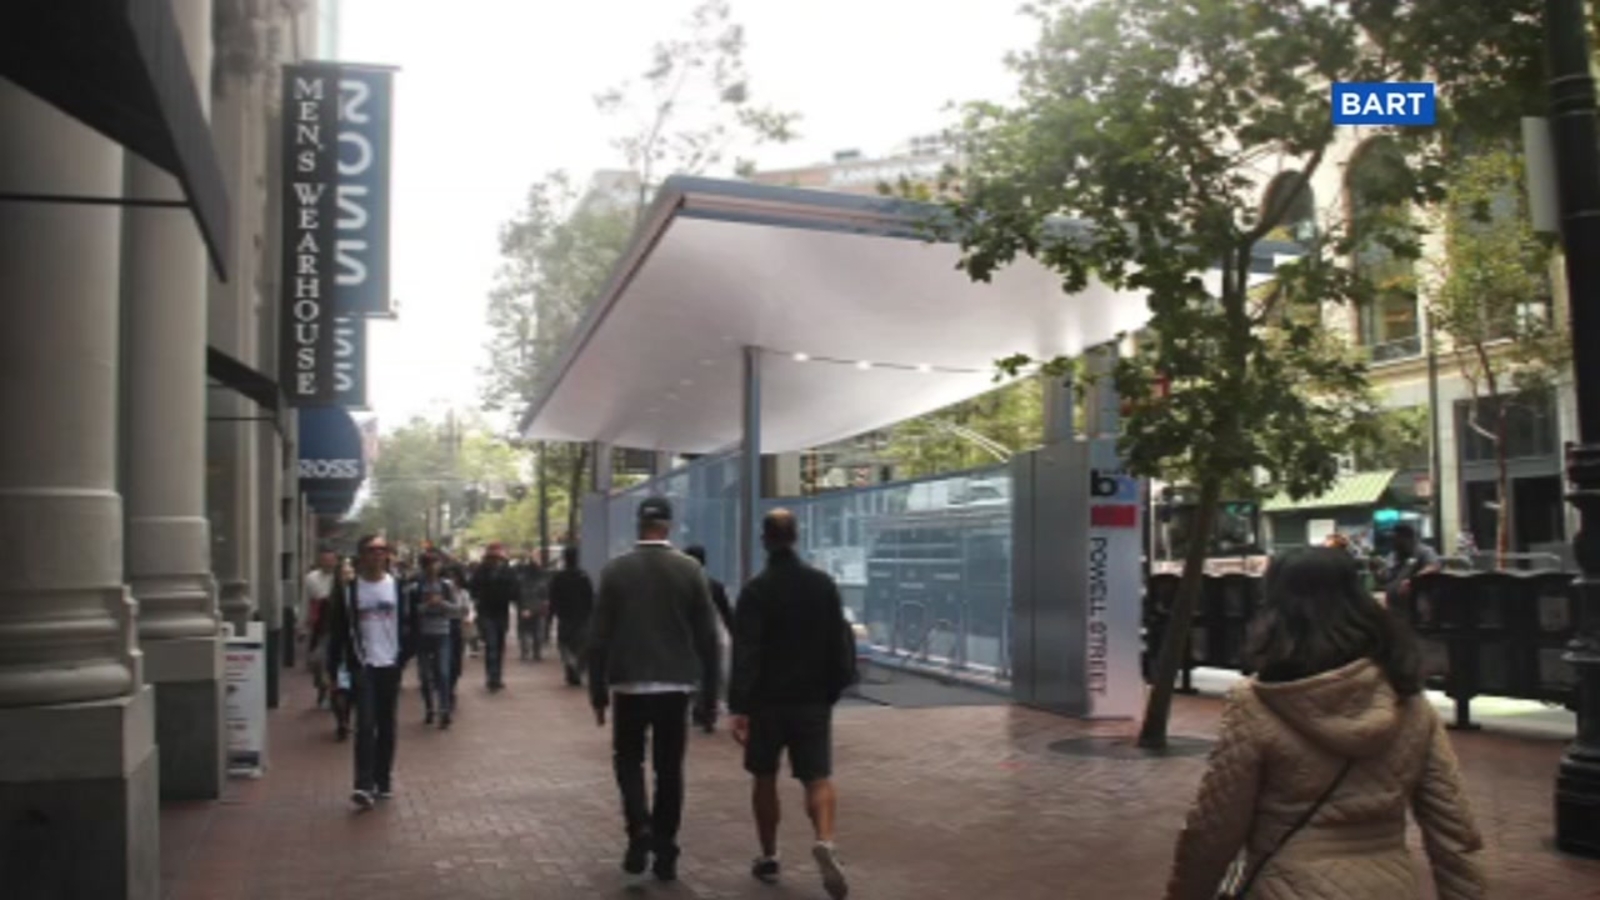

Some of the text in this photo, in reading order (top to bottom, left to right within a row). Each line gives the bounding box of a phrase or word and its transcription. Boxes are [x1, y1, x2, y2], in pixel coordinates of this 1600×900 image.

[293, 77, 326, 395] MEN'S WEARHOUSE
[299, 459, 358, 478] ROSS
[1089, 537, 1107, 696] POWELL STREET
